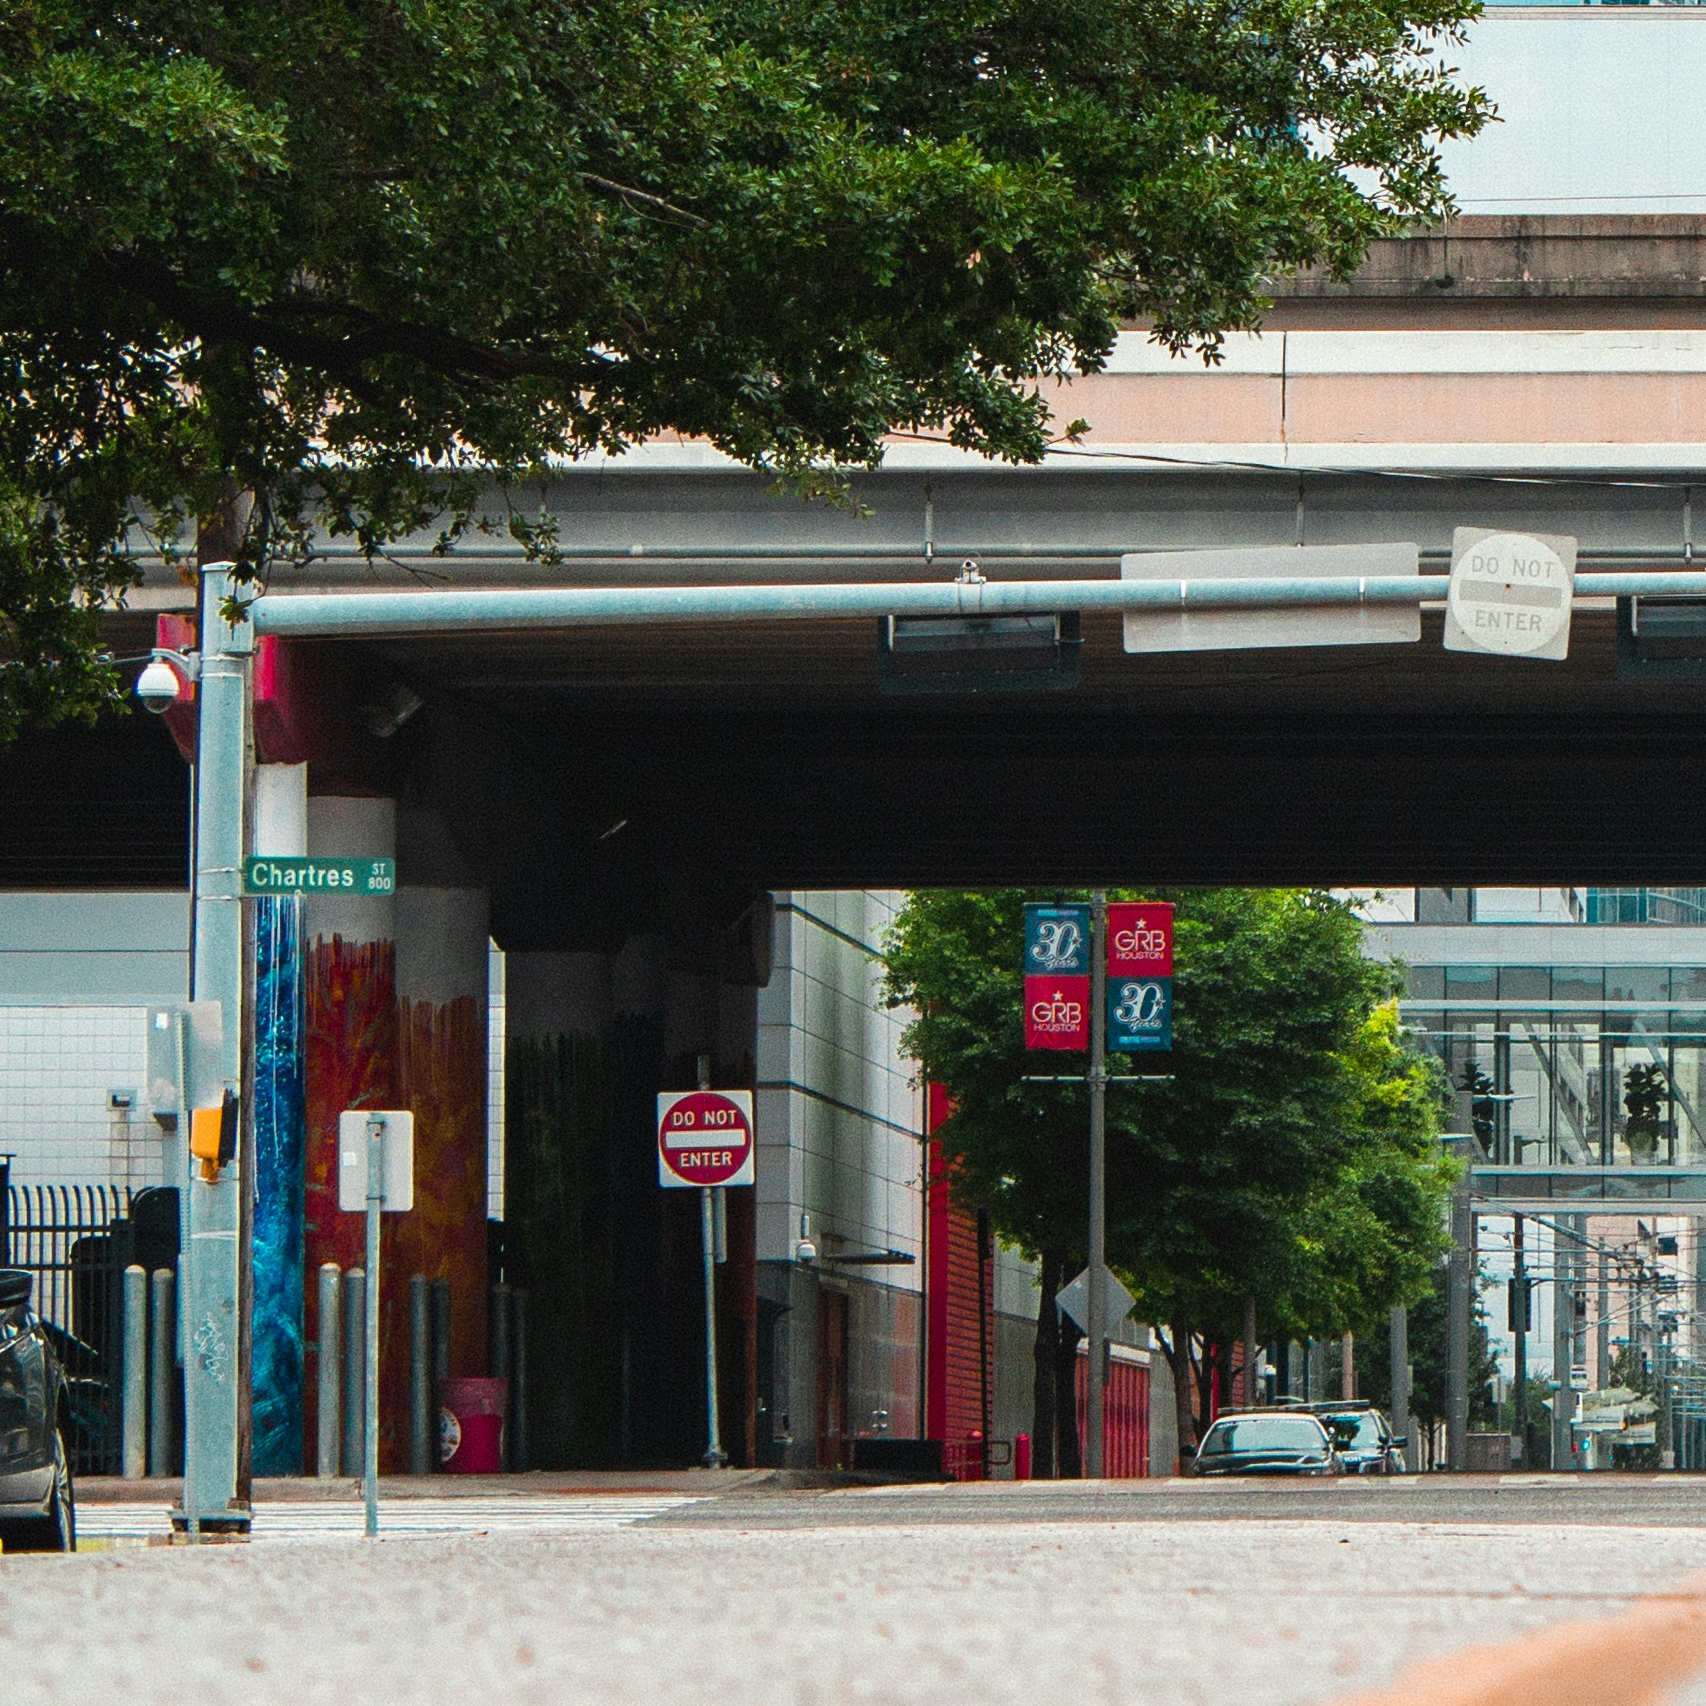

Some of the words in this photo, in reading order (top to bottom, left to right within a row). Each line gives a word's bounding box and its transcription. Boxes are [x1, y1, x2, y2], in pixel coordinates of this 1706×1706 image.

[1472, 555, 1499, 574] DO
[1513, 559, 1555, 578] NOT
[1475, 610, 1542, 632] ENTER
[252, 863, 354, 887] Chartres
[372, 863, 386, 875] ST
[368, 877, 391, 890] 800
[1030, 921, 1081, 963] 30
[1115, 930, 1166, 951] GRB
[1116, 951, 1164, 960] HOUSTON
[1032, 1002, 1082, 1024] GRB
[1114, 982, 1164, 1024] 30
[1033, 1023, 1080, 1032] HOUSTON
[673, 1111, 696, 1126] DO
[704, 1110, 737, 1125] NOT
[680, 1151, 732, 1167] ENTER
